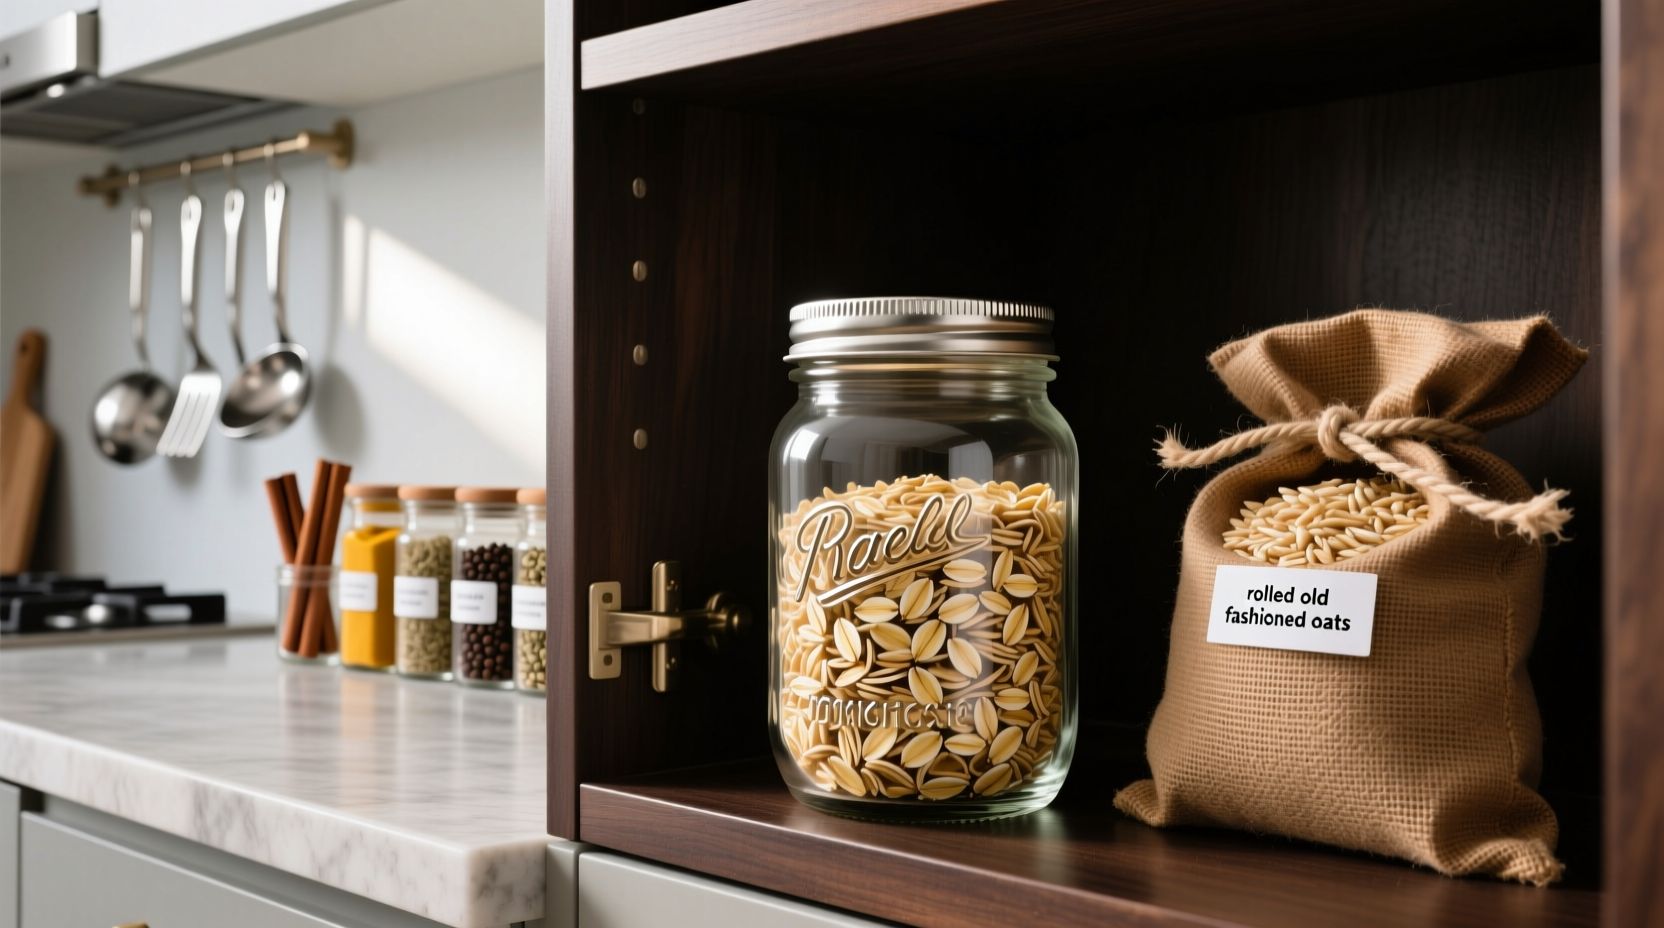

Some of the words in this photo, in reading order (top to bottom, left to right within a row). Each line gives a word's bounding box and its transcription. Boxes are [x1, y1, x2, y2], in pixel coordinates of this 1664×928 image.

[1247, 584, 1295, 603] rolled
[1300, 587, 1330, 606] old
[1225, 605, 1307, 628] fashioned
[1311, 614, 1351, 631] oats
